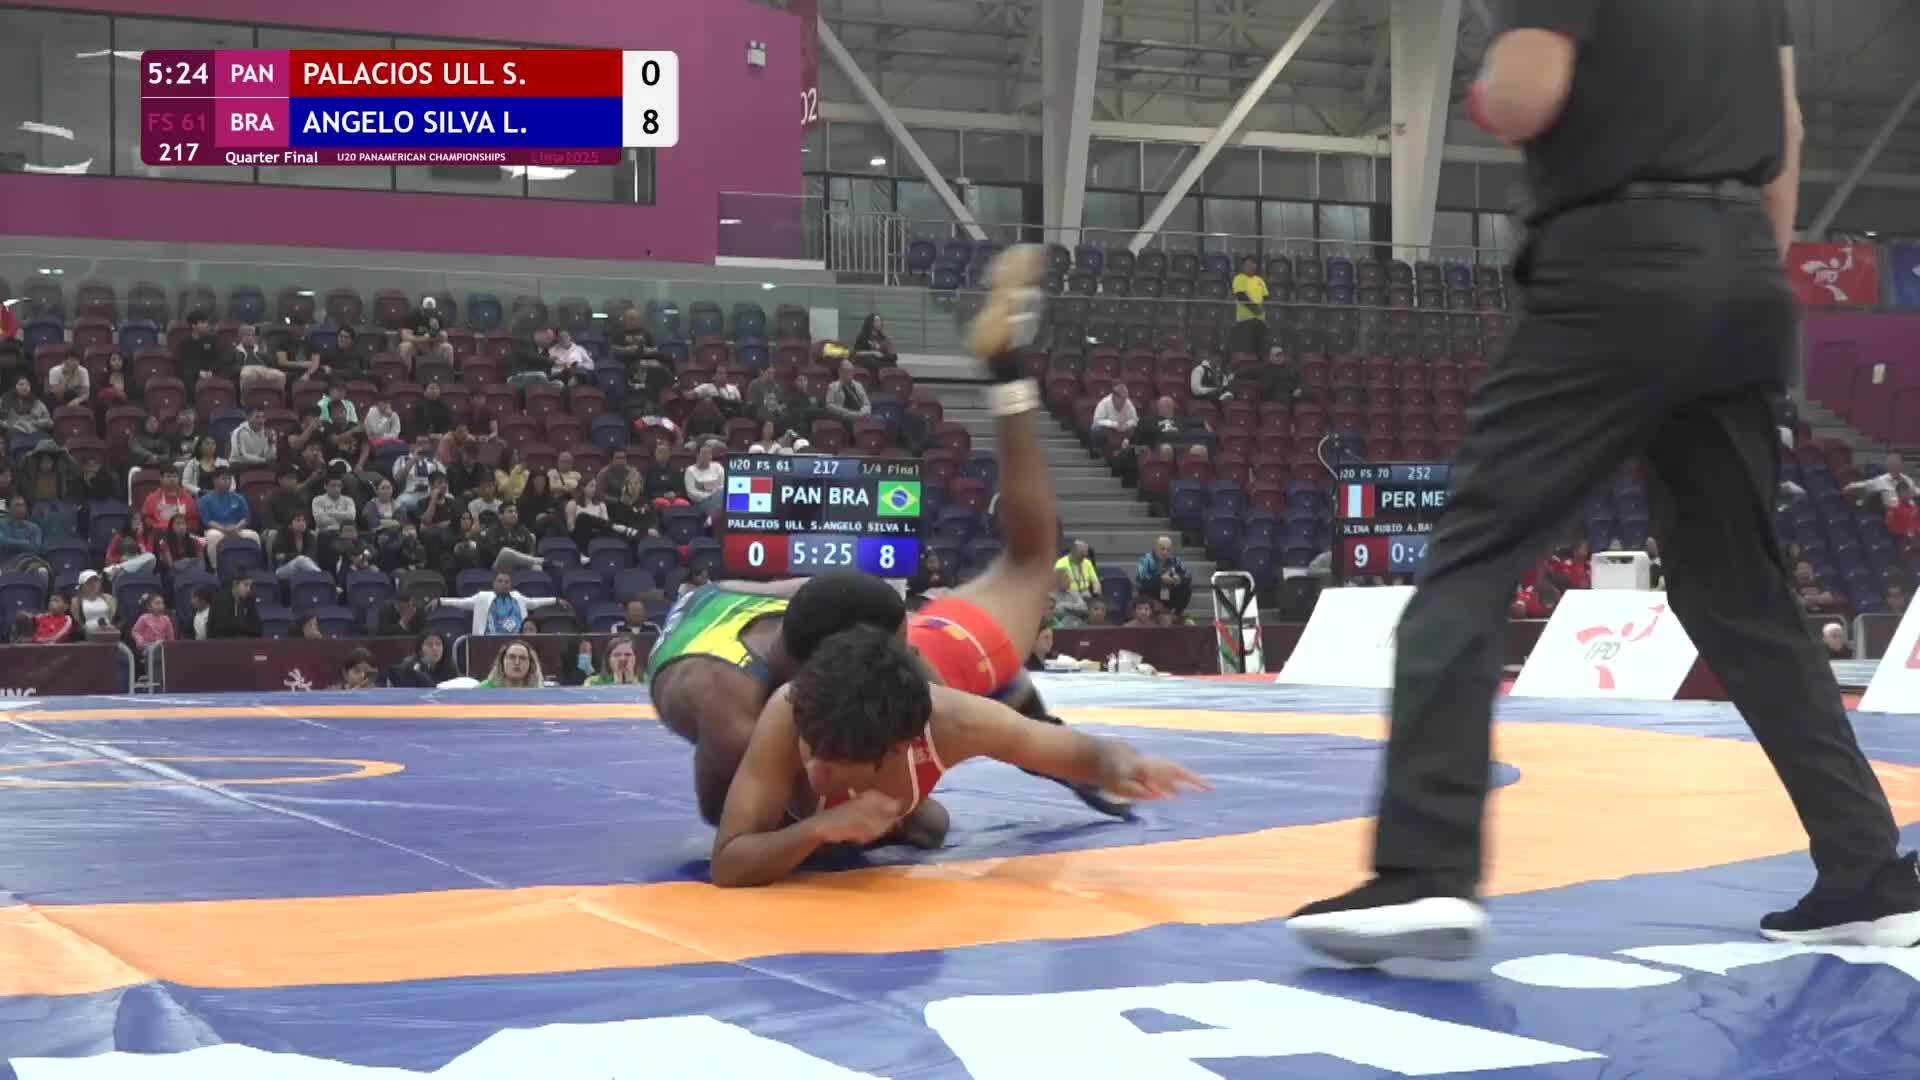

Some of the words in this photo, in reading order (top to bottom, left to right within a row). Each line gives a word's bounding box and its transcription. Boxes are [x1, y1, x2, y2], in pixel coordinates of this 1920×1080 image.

[729, 459, 750, 470] U20
[757, 461, 770, 471] FS
[776, 460, 790, 472] 61
[813, 461, 839, 474] 217
[1407, 466, 1432, 481] 252
[780, 486, 821, 505] PAN
[828, 487, 869, 506] BRA
[1381, 491, 1416, 508] PER
[1421, 491, 1450, 507] ME
[728, 519, 780, 529] PALACIOS
[785, 519, 804, 530] ULL
[867, 522, 899, 532] SILVA
[904, 522, 917, 533] L.
[748, 541, 765, 567] 0
[793, 541, 852, 566] 5:25
[879, 545, 895, 569] 8
[1354, 544, 1369, 568] 9
